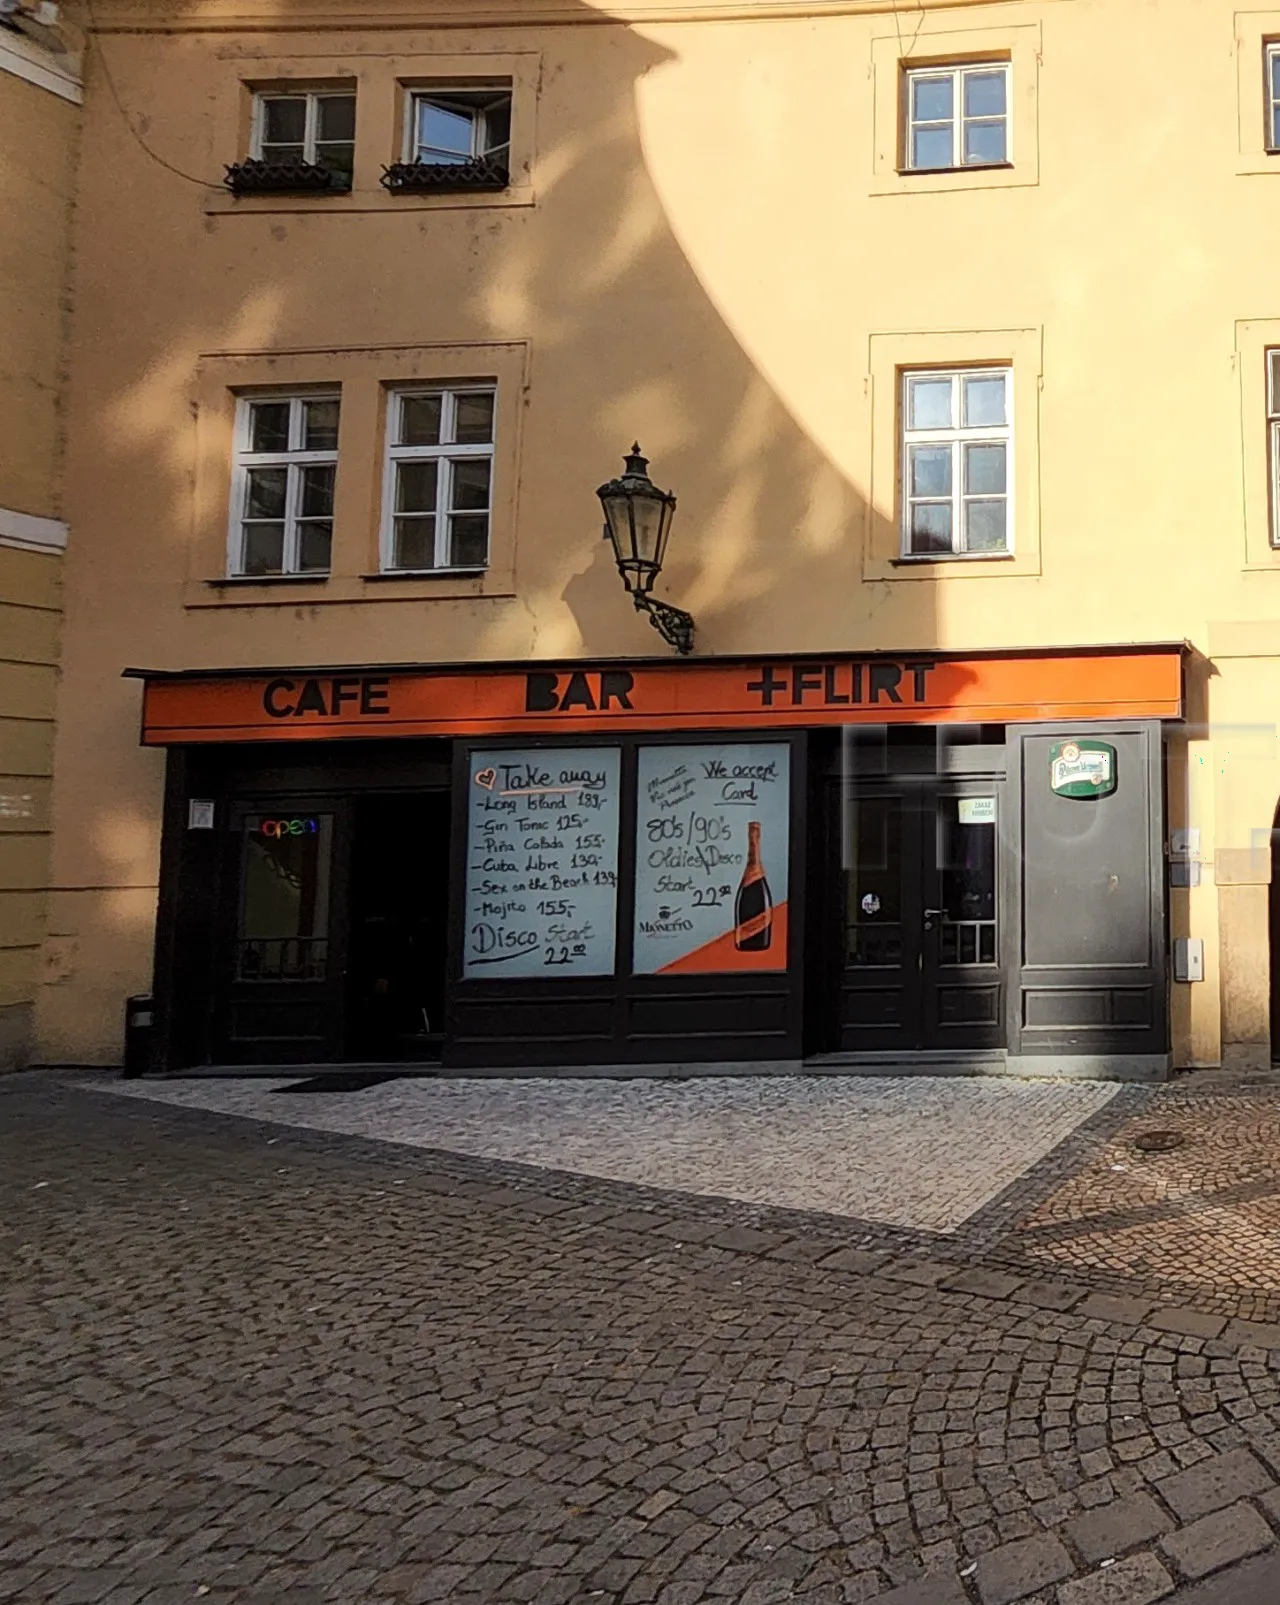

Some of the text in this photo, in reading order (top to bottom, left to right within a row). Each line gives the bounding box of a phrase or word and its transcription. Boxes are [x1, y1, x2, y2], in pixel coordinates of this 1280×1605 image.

[263, 677, 391, 719] CAFE
[525, 670, 634, 712] BAR
[499, 764, 606, 790] Take away
[701, 760, 779, 783] We accept
[721, 781, 758, 801] Card
[527, 795, 566, 811] Island
[263, 820, 317, 838] open
[515, 817, 549, 832] Tonic
[523, 836, 564, 850] Colada
[525, 855, 559, 871] Libre
[512, 884, 526, 893] on
[529, 878, 549, 890] the
[550, 872, 588, 891] Beach
[653, 875, 696, 893] Start
[471, 920, 596, 954] Disco Start
